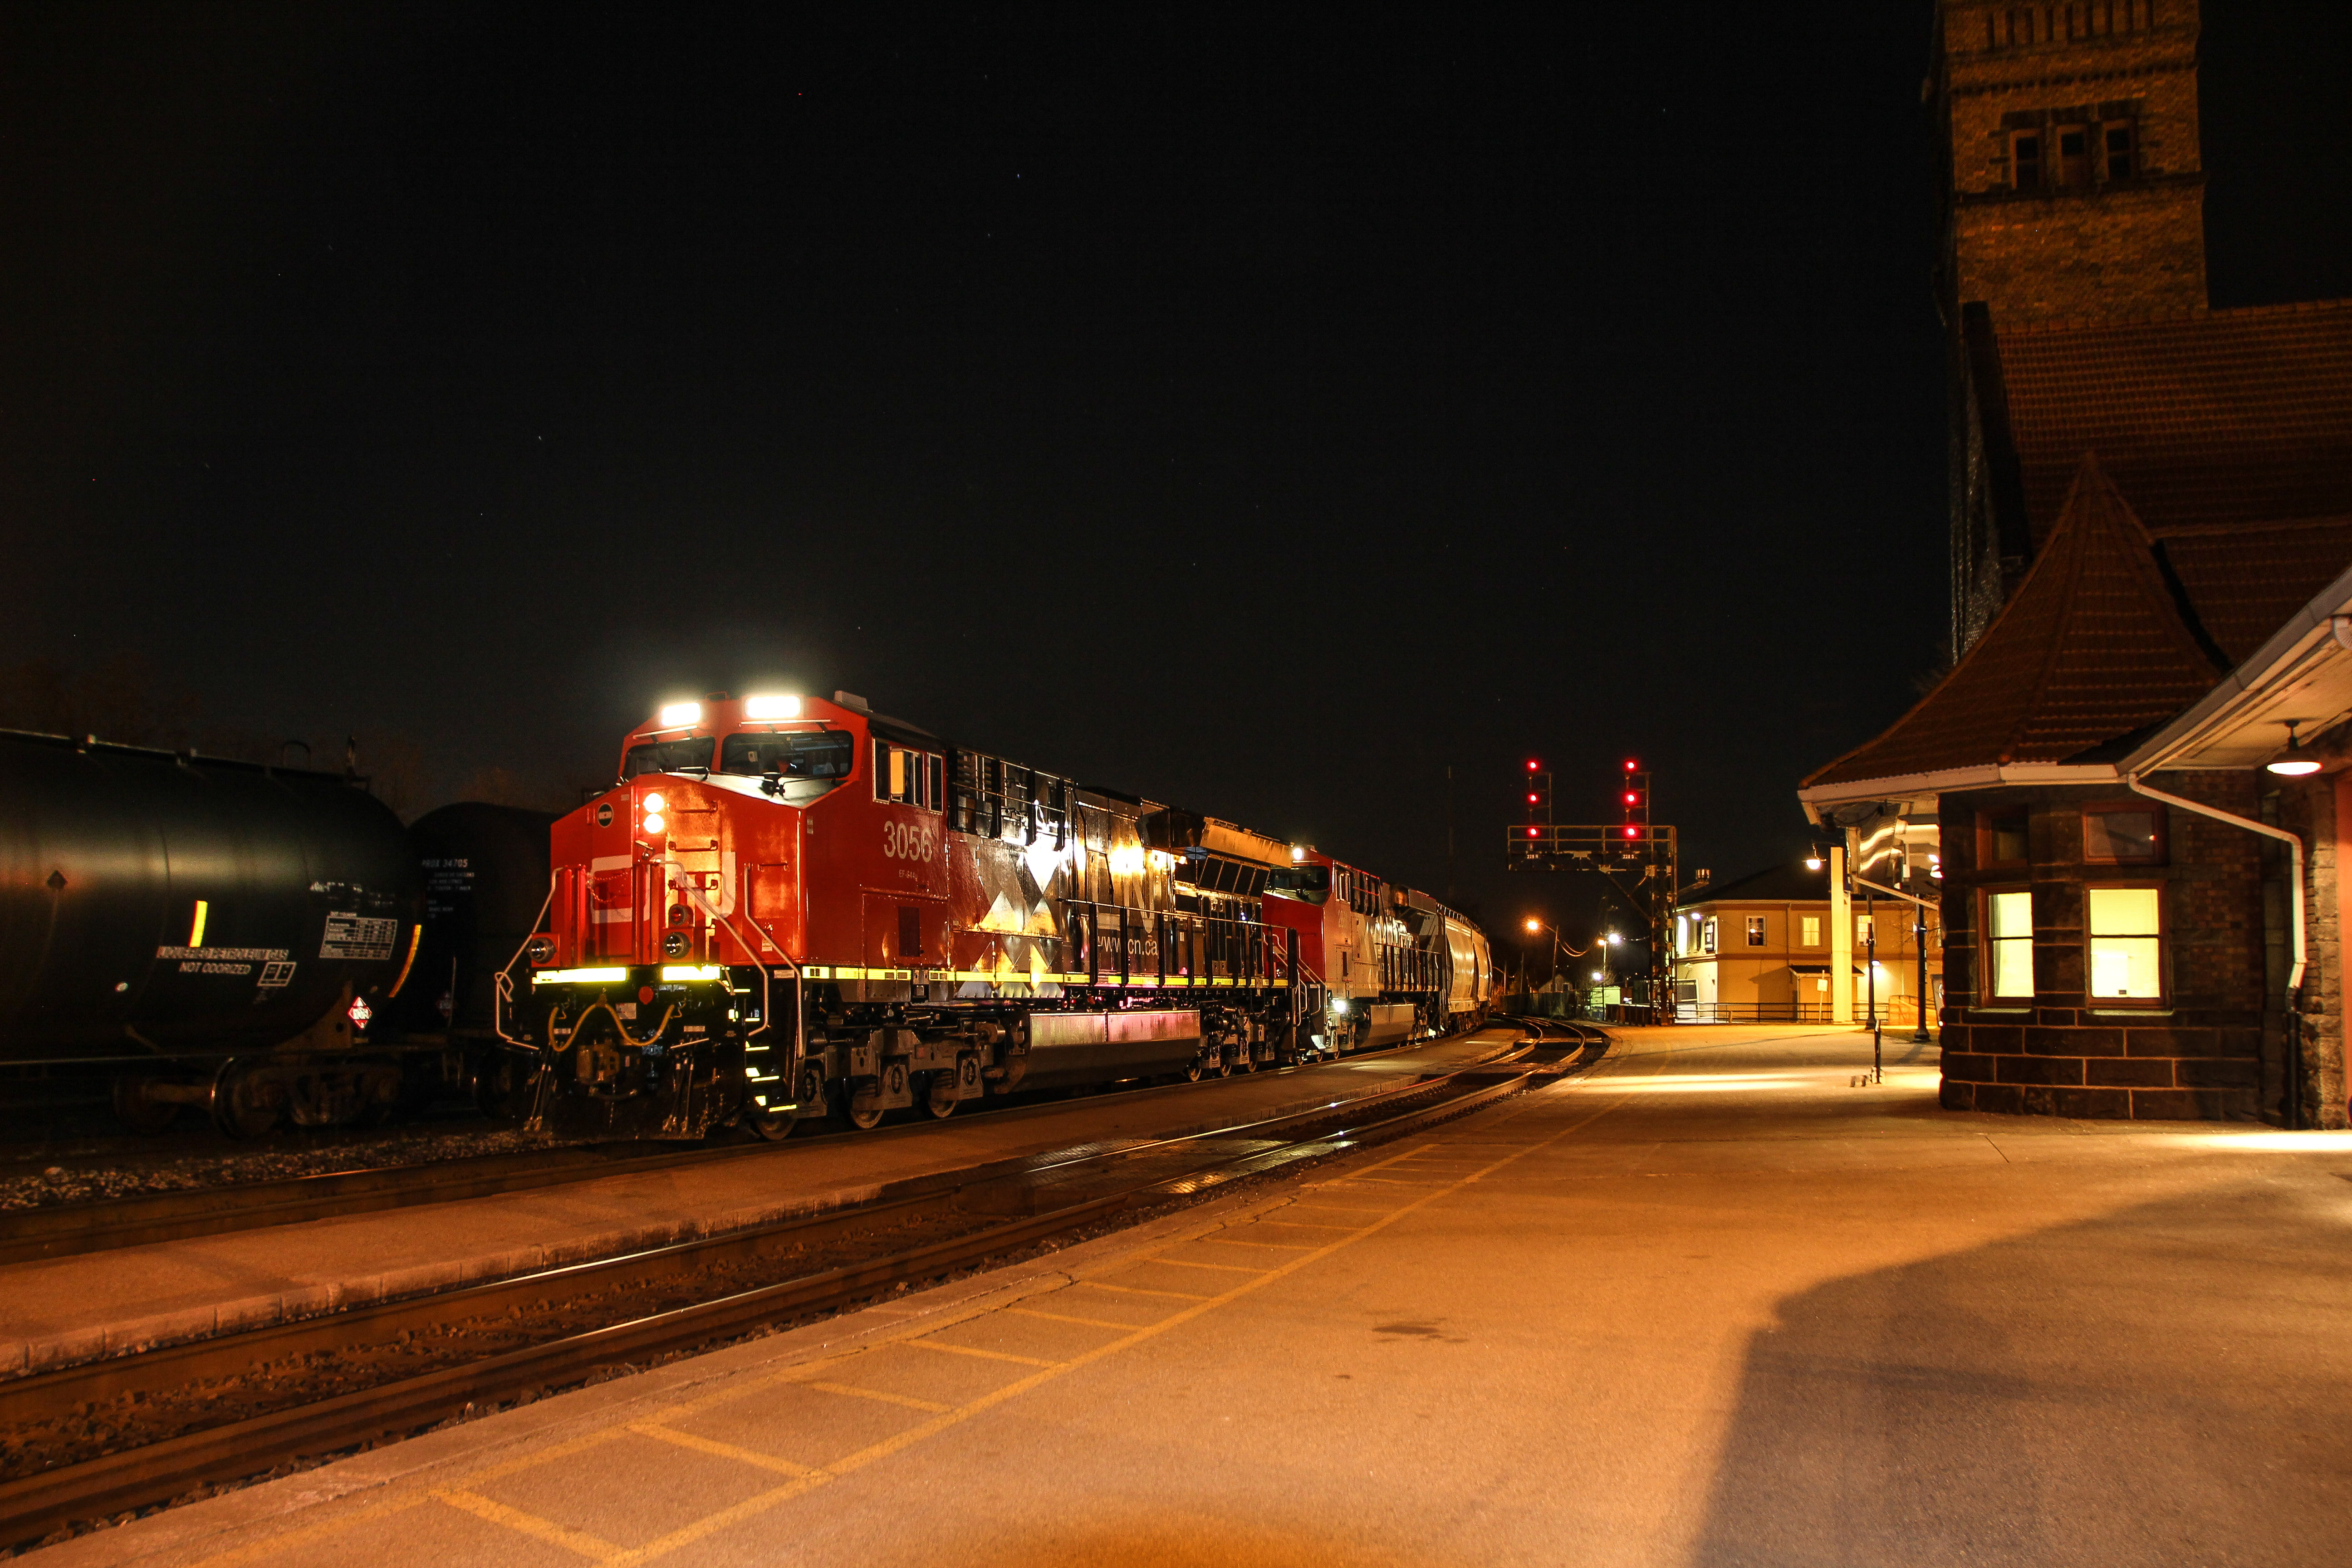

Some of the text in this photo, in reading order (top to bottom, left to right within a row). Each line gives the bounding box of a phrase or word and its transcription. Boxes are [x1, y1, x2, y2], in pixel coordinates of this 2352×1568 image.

[884, 821, 932, 862] 3056
[1098, 936, 1158, 956] wwwcn.ca
[179, 961, 202, 973] NOT
